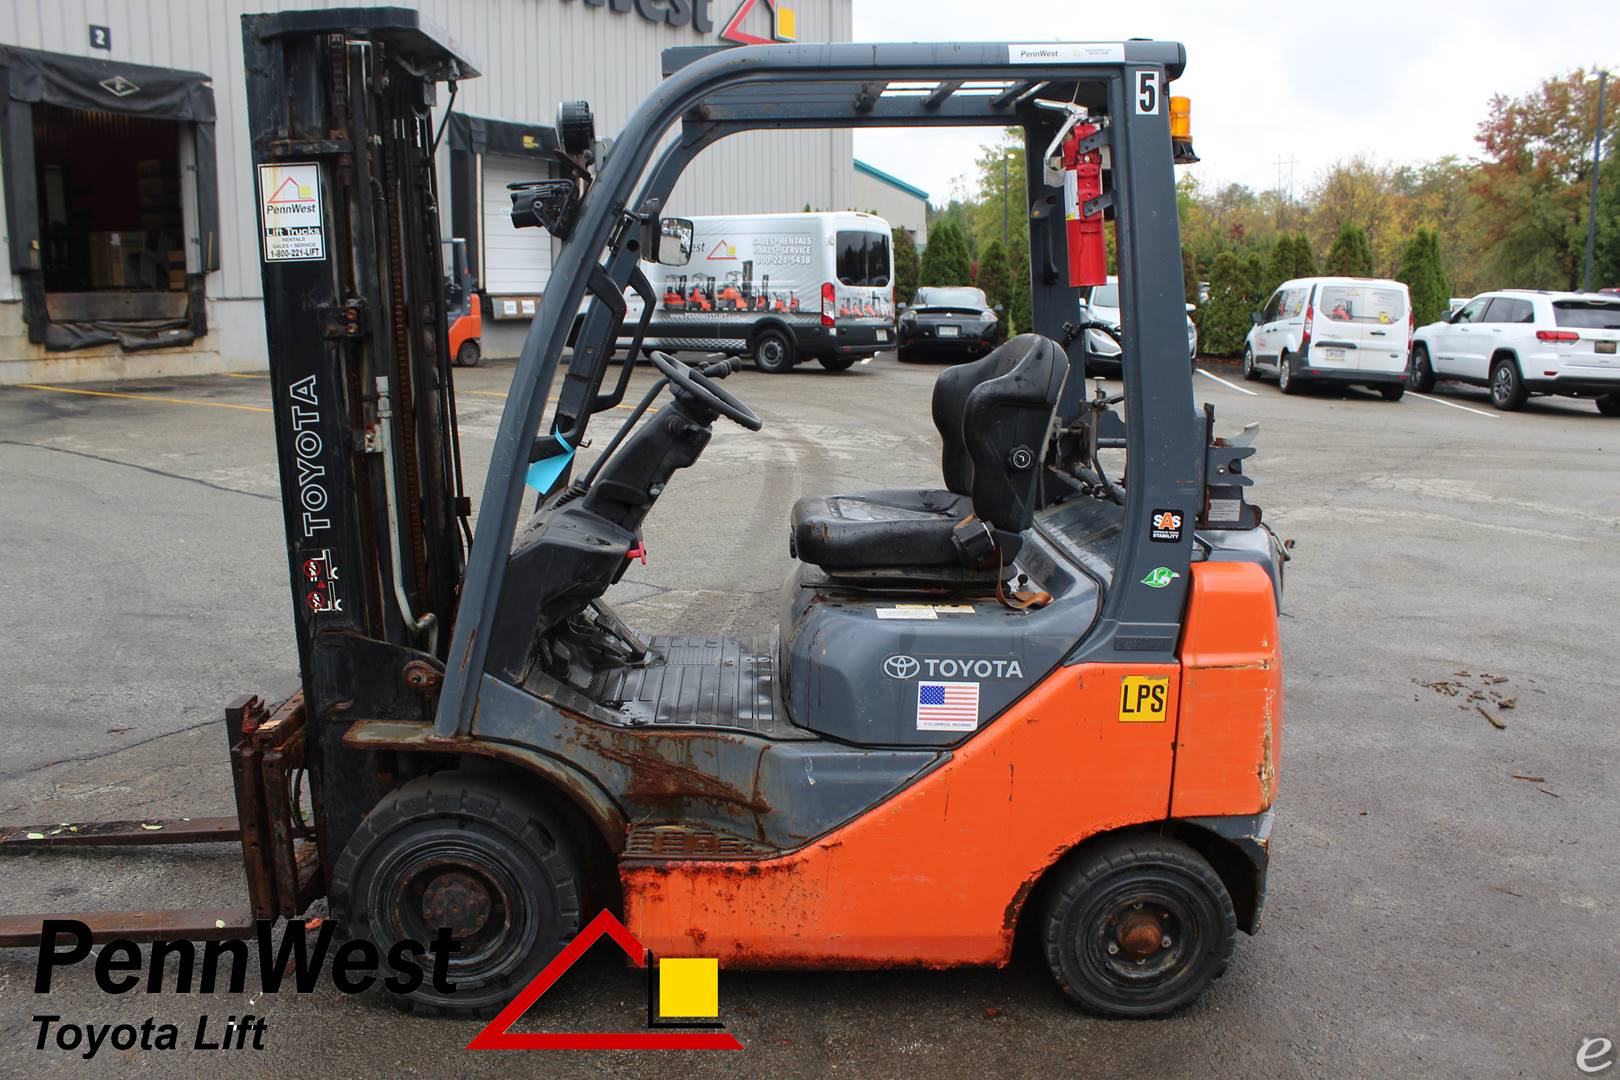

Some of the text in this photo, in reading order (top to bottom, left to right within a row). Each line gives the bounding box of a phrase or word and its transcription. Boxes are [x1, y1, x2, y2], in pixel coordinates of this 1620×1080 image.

[95, 29, 106, 45] 2
[1140, 73, 1156, 112] 5
[266, 204, 316, 214] PennWest
[267, 226, 320, 237] Lift Trucks
[271, 248, 319, 257] 1-800-221-LIFT
[782, 246, 811, 254] SERVICE
[289, 374, 331, 537] TOYOTA
[1153, 511, 1181, 529] SAS
[924, 659, 1024, 679] TOYOTA
[1122, 684, 1165, 713] LPS
